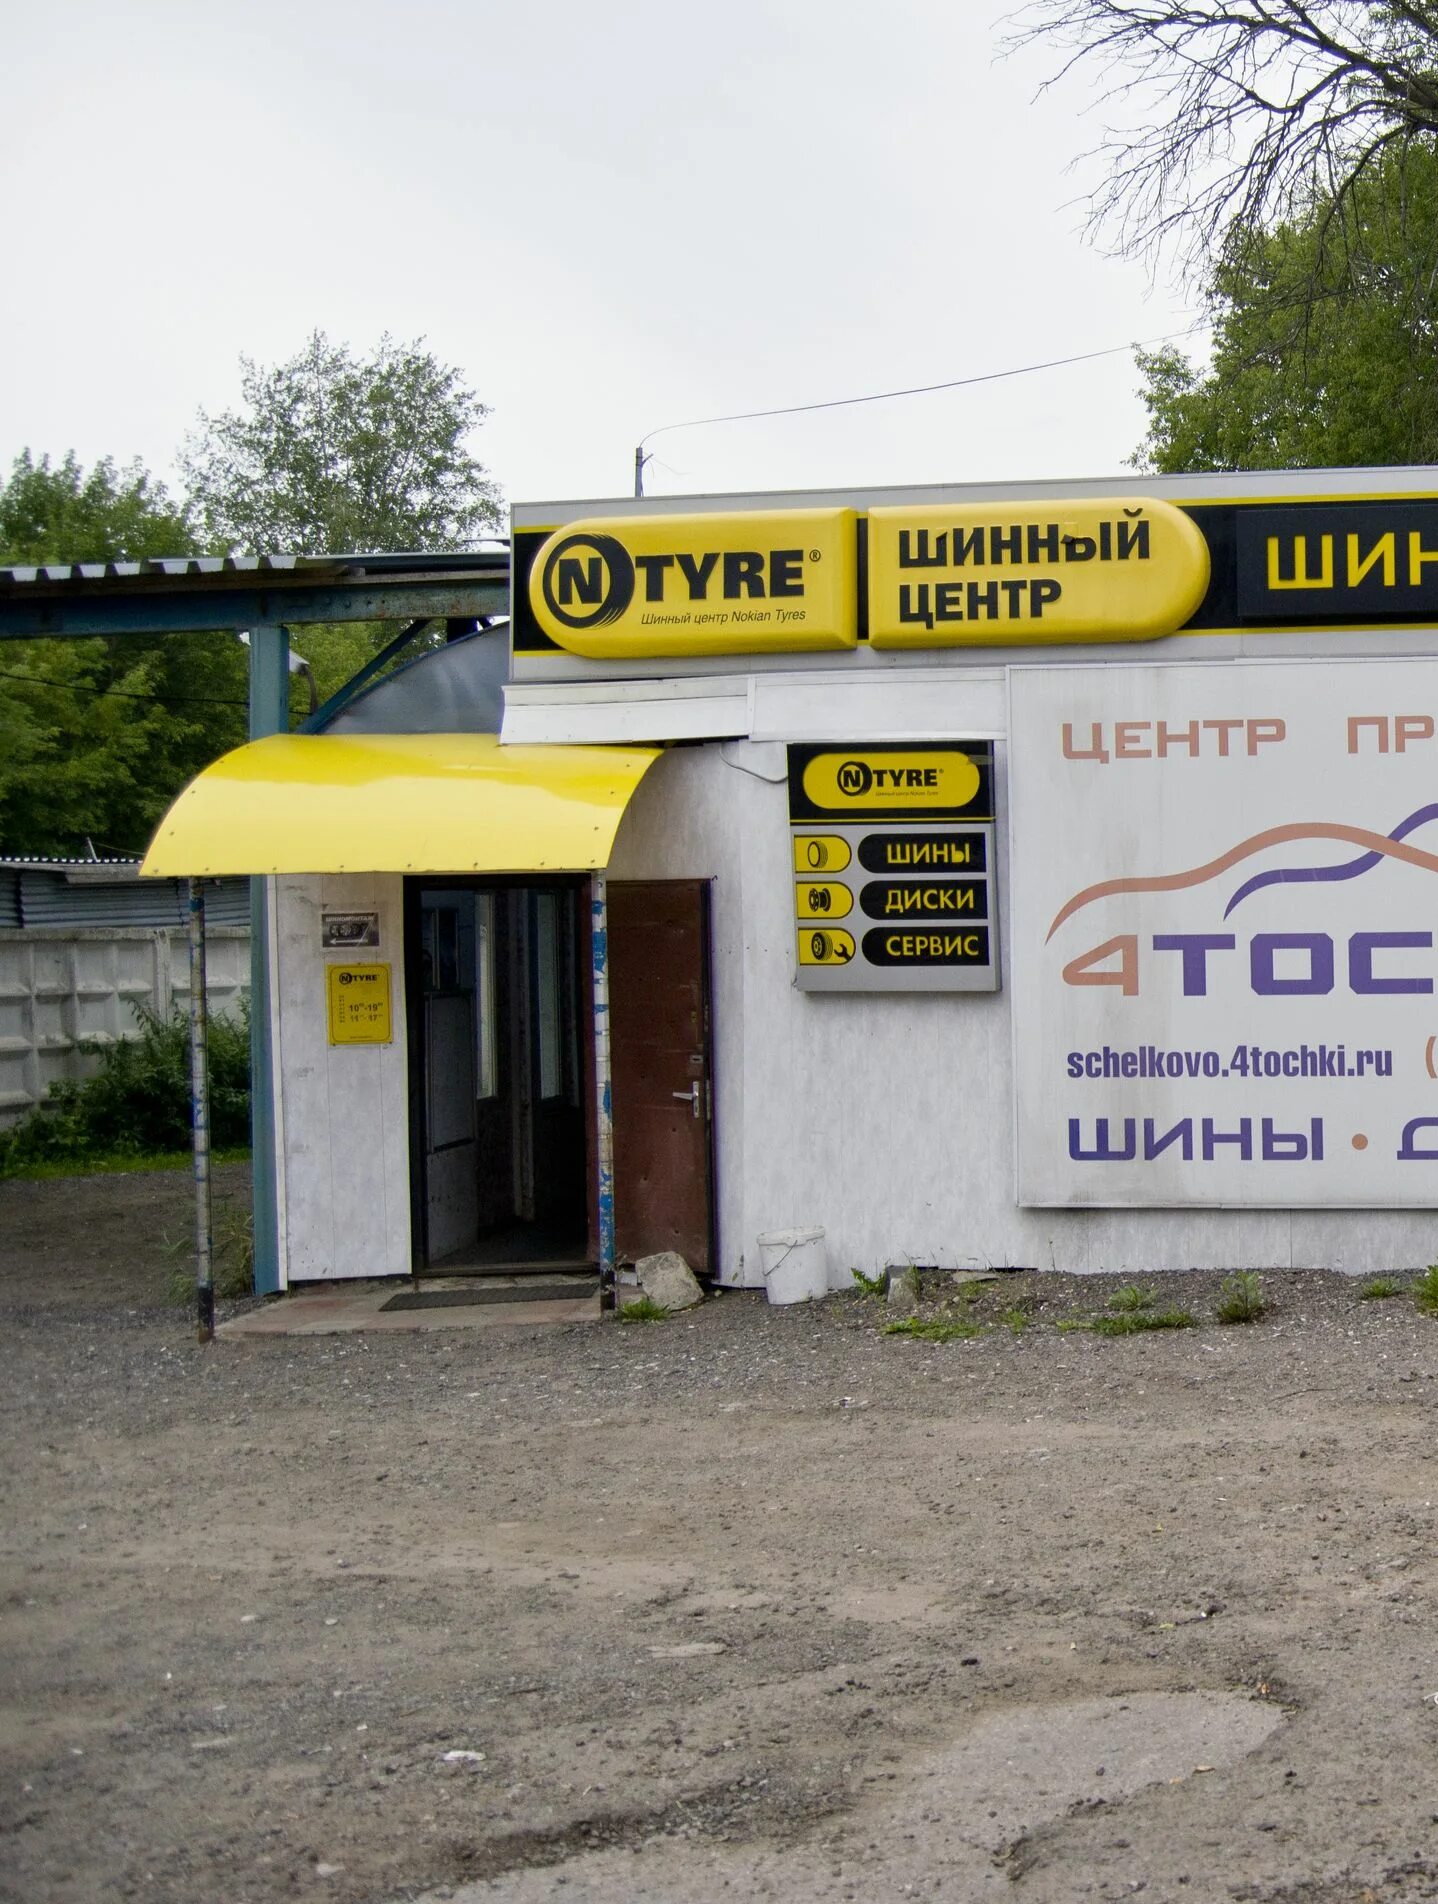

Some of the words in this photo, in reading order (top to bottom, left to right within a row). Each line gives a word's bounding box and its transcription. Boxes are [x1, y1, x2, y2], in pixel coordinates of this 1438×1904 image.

[899, 507, 1151, 568] ШИННЫЙ
[641, 612, 691, 625] Шинный
[694, 613, 728, 626] центр
[731, 610, 771, 622] Nokian
[775, 609, 806, 623] Tyres
[899, 578, 1062, 630] ЦЕНТР
[1062, 717, 1287, 765] ЦЕНТР
[887, 842, 971, 865] ШИНЫ
[885, 888, 975, 914] ДИСКИ
[885, 935, 980, 957] СЕРВИС
[1067, 1044, 1393, 1079] schelkovo.4tochki.ru
[1067, 1117, 1325, 1162] ШИНЫ
